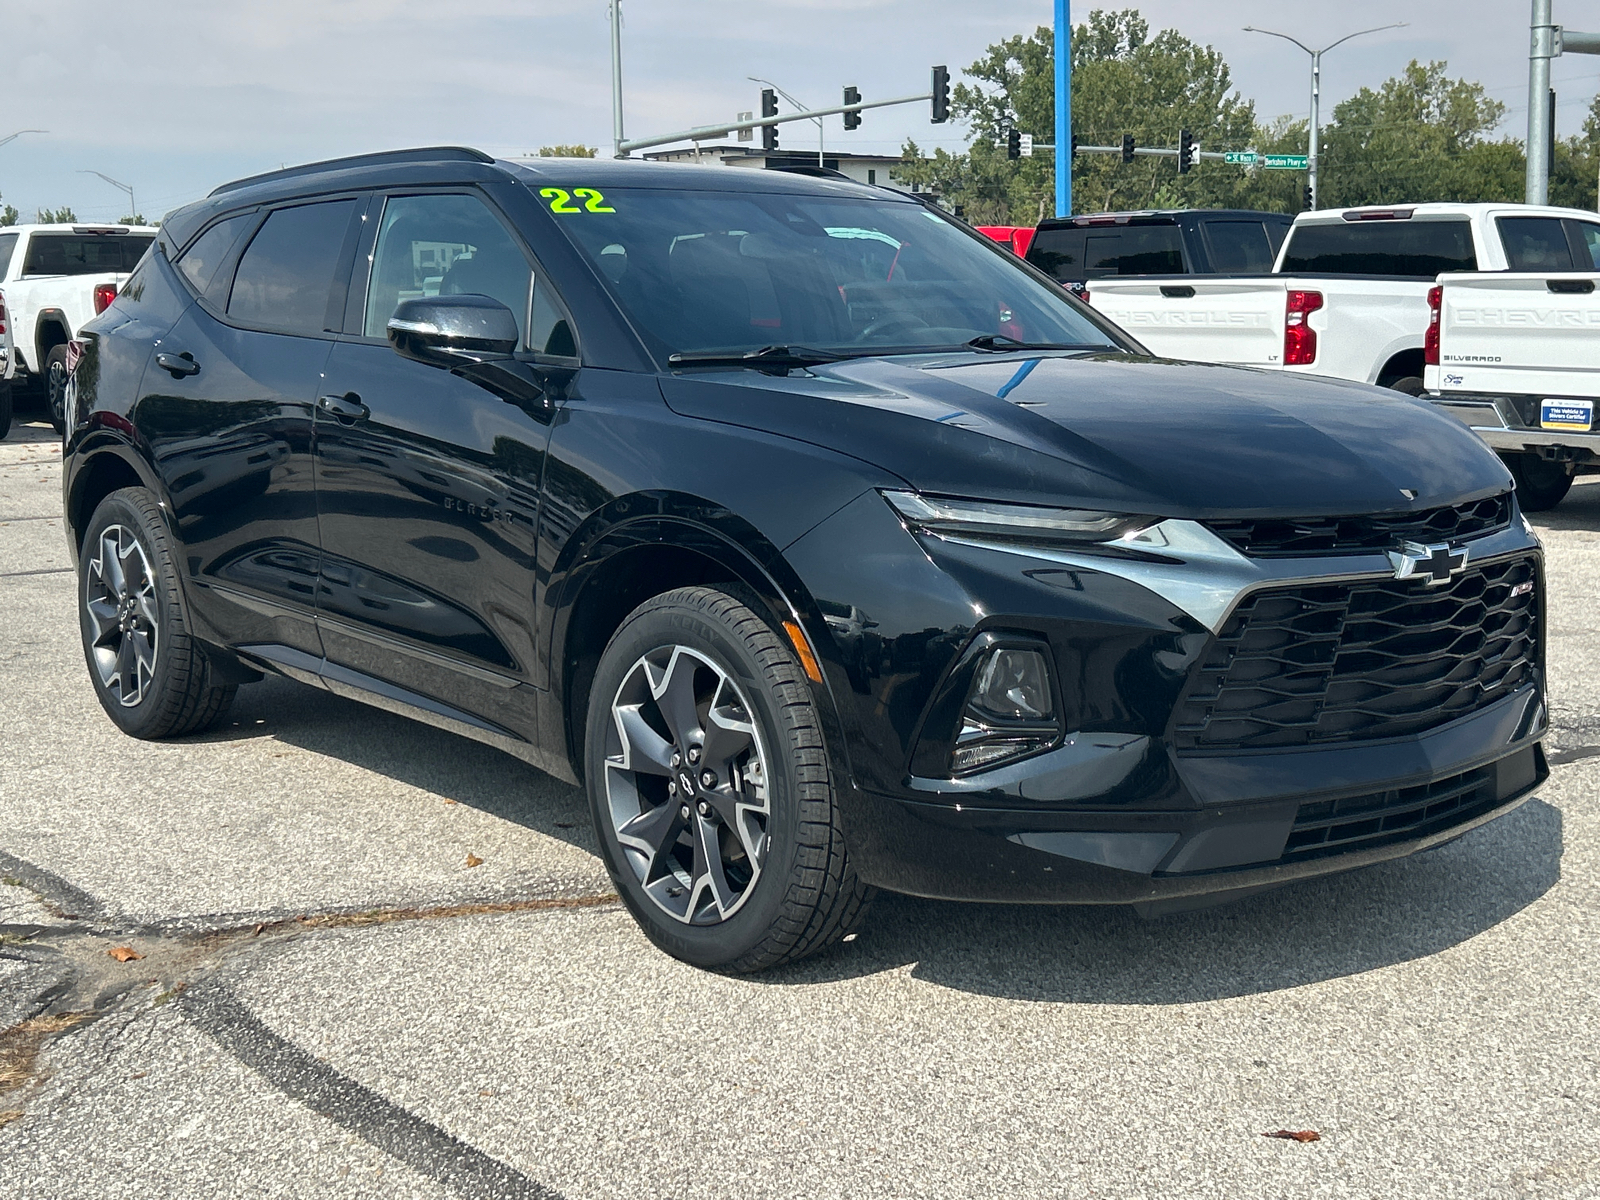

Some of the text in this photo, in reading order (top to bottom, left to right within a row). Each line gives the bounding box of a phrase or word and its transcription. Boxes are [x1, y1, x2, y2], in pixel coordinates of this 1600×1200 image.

[1265, 158, 1301, 168] Berkshire Pkwy
[539, 187, 616, 214] 22
[1443, 354, 1502, 363] SILVERADO
[443, 497, 514, 525] BLAZER
